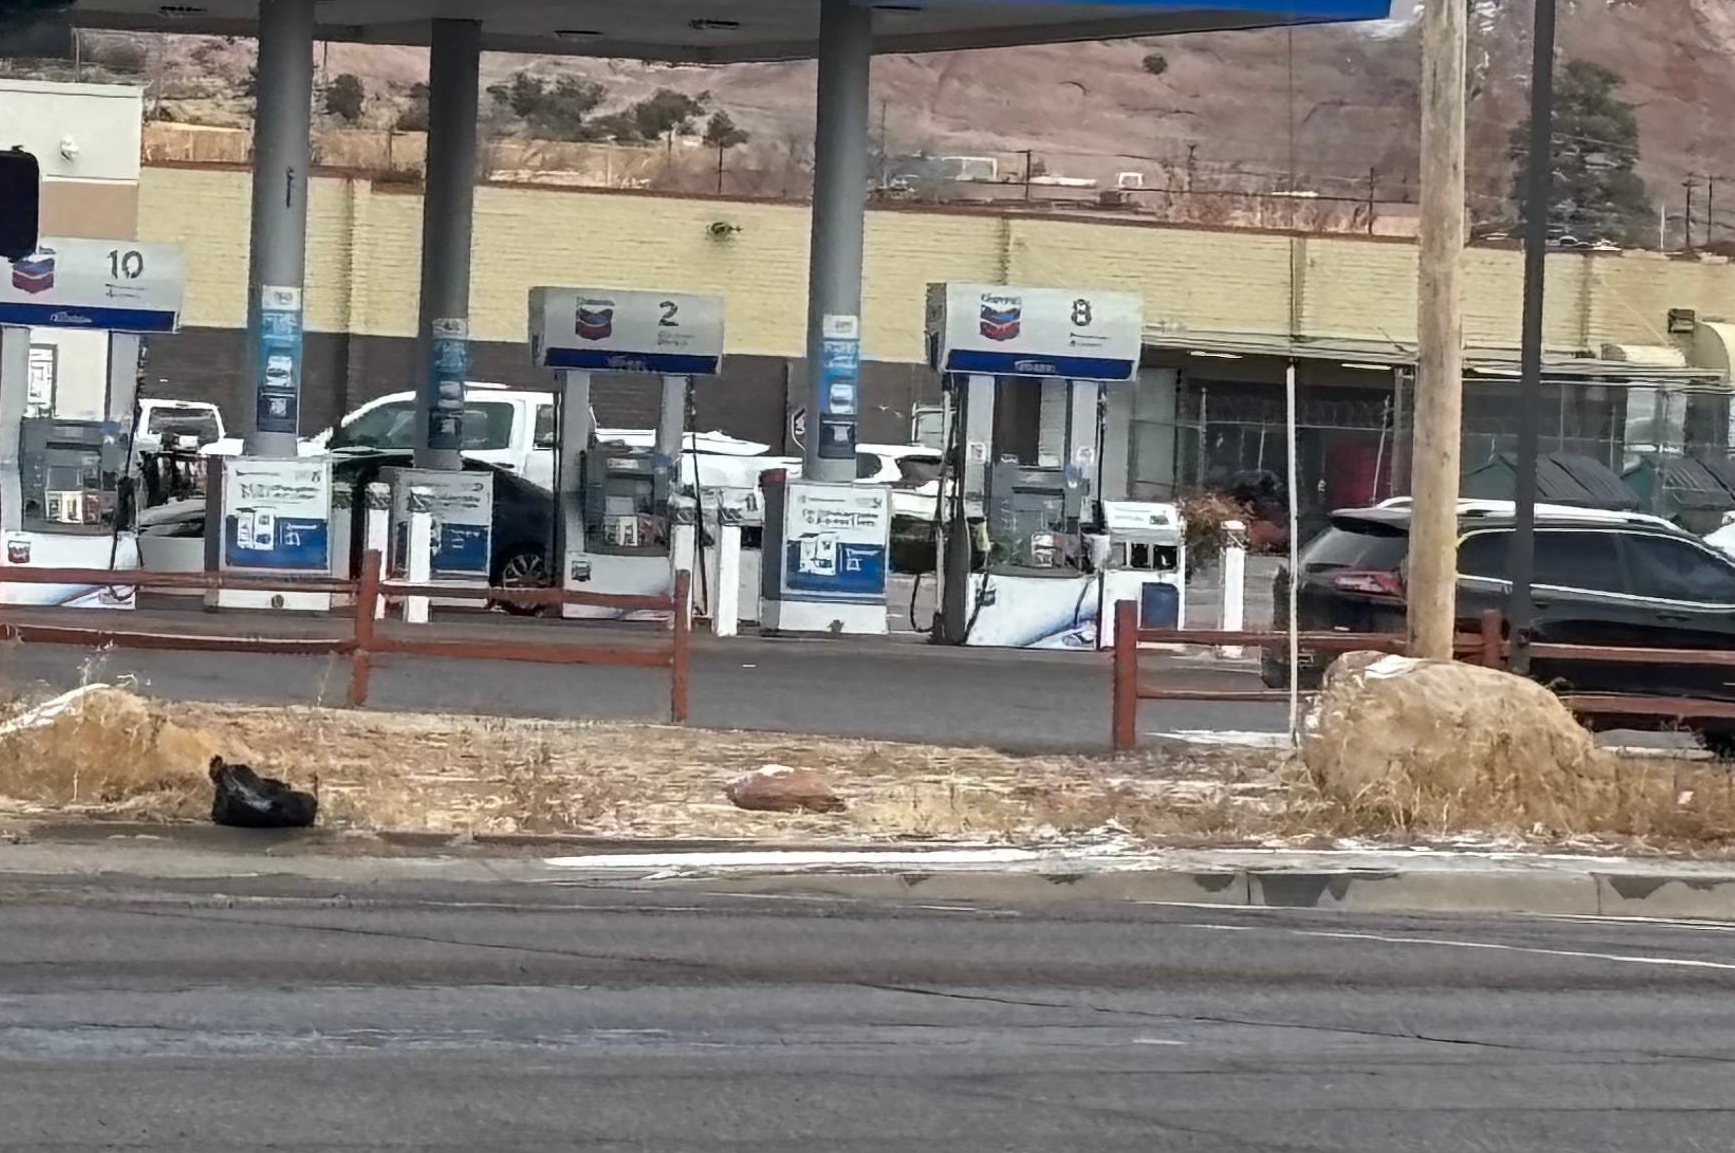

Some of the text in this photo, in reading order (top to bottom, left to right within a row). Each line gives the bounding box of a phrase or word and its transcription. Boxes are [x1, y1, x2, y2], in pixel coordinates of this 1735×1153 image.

[107, 249, 143, 279] 10
[658, 300, 679, 326] 2
[1071, 299, 1092, 326] 8
